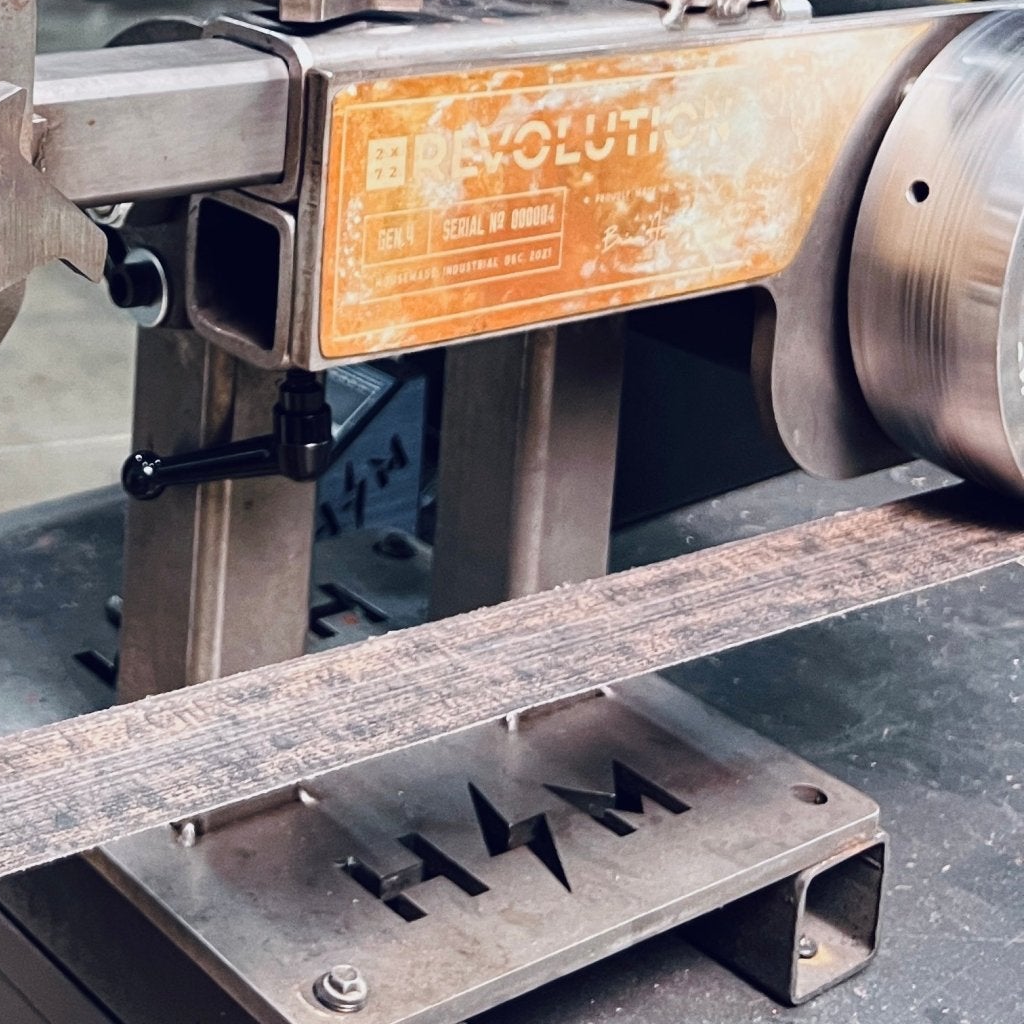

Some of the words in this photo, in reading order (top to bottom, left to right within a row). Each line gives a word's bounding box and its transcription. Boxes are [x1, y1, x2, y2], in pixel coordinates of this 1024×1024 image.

[441, 214, 486, 242] SERIAL
[510, 202, 556, 230] 000004
[442, 256, 499, 278] INDUSTRIAL
